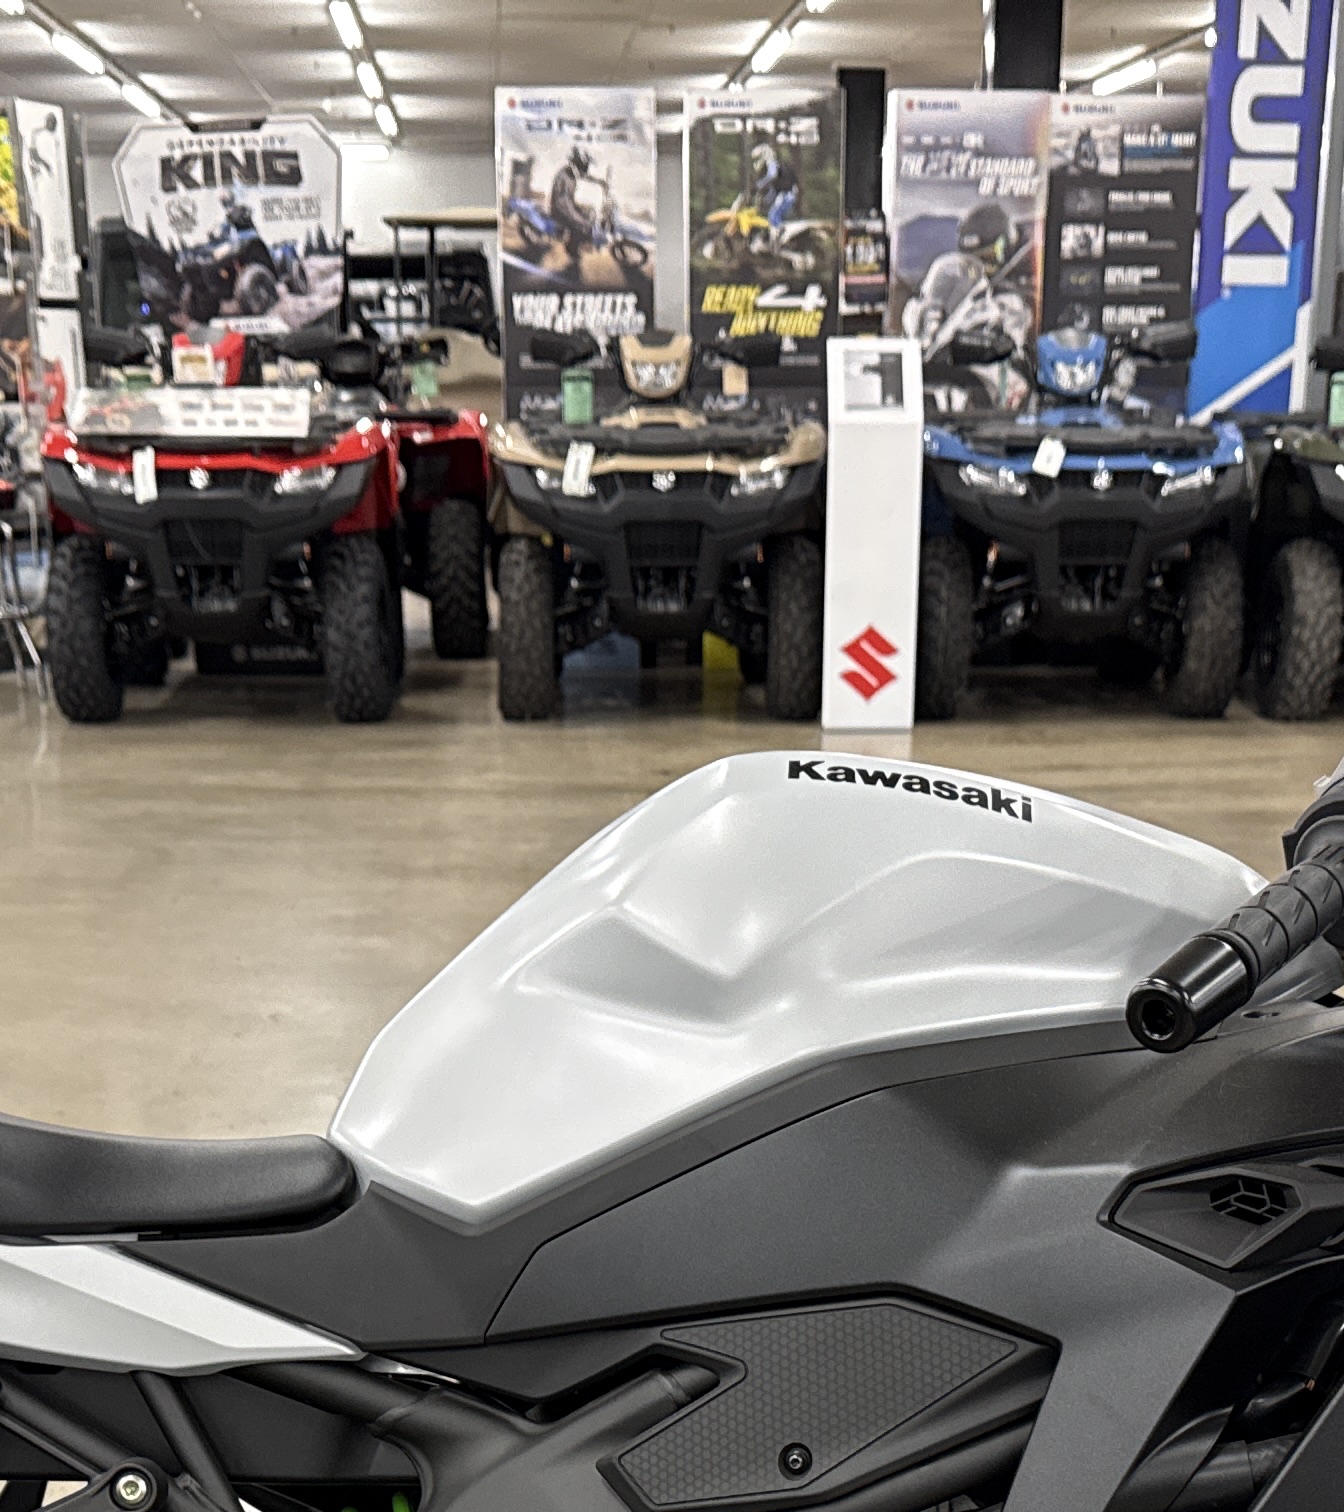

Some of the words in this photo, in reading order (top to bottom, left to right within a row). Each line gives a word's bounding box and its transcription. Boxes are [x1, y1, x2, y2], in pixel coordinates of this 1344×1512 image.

[160, 149, 303, 193] KING
[702, 284, 761, 314] READY
[729, 310, 824, 338] ANYTHING
[787, 758, 1034, 824] Kawasaki
